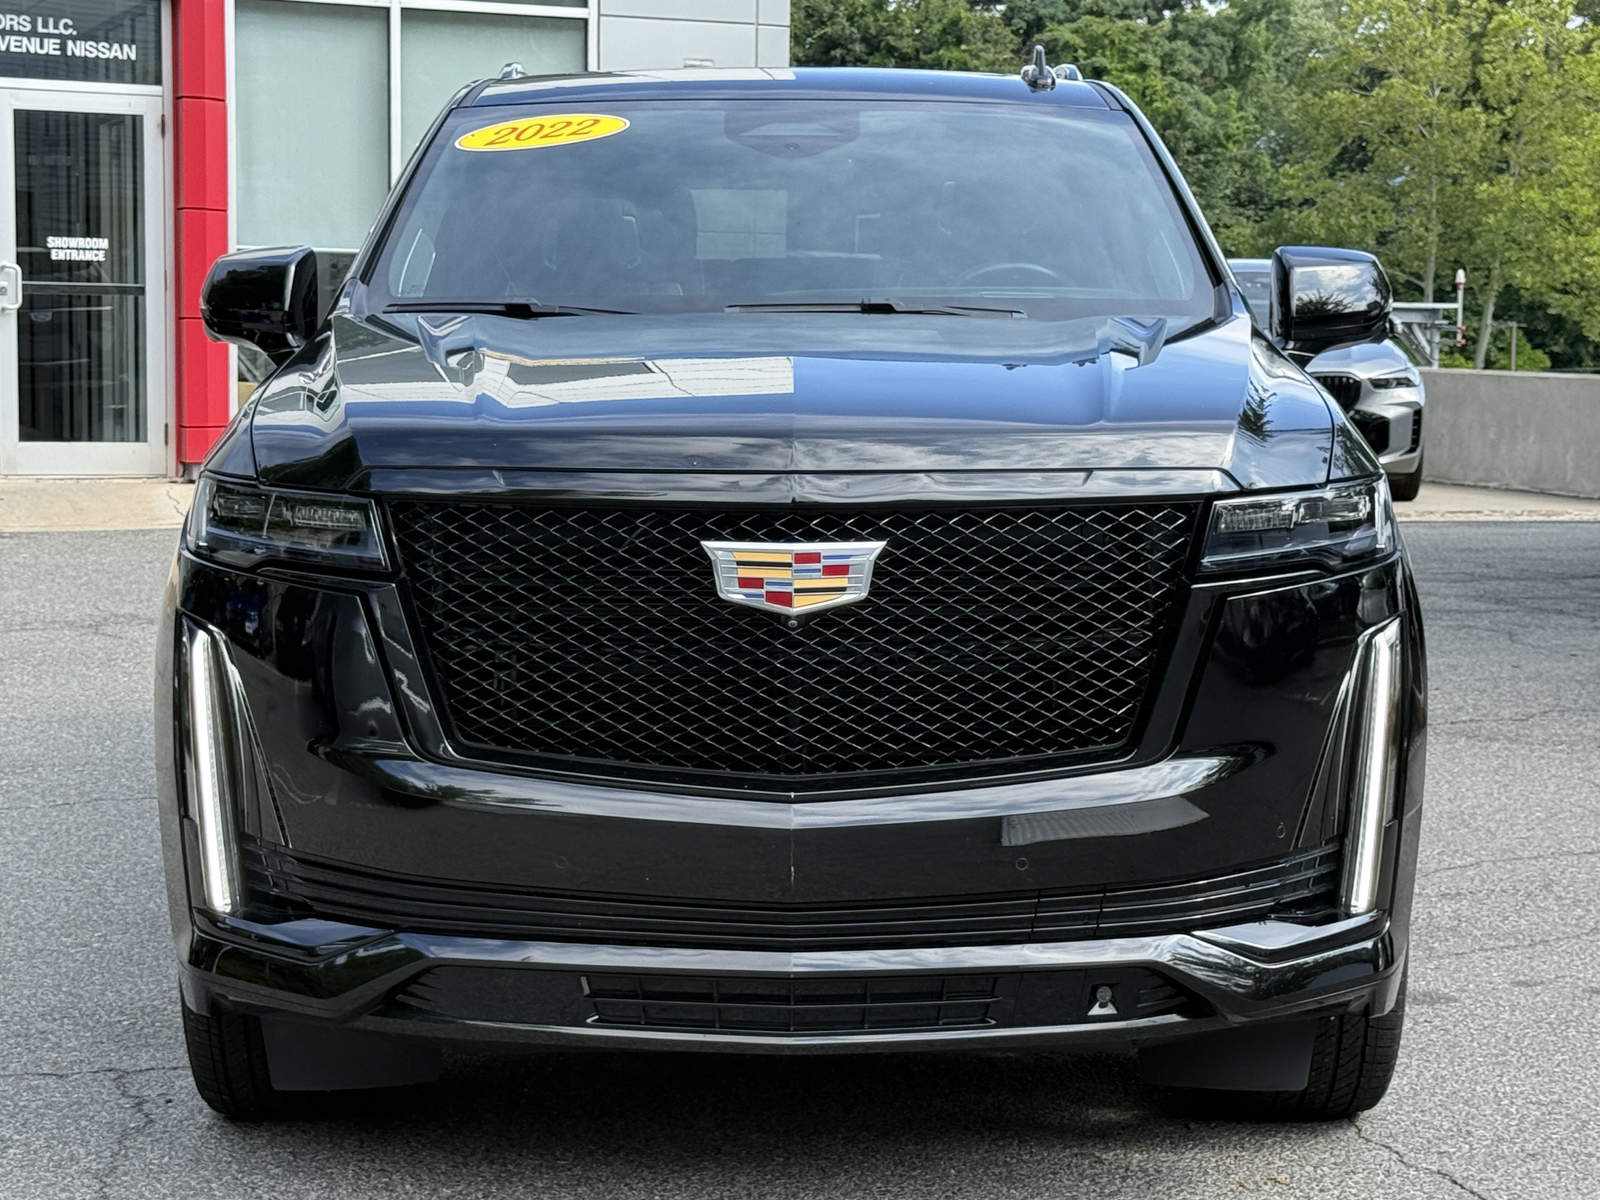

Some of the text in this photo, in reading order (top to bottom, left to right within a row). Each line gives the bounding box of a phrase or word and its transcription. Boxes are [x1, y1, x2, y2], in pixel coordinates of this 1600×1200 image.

[36, 16, 77, 36] LLC.
[66, 40, 137, 61] NISSAN
[484, 119, 600, 147] 2022
[46, 236, 109, 249] SHOWROOM
[50, 249, 106, 261] ENTRANCE
